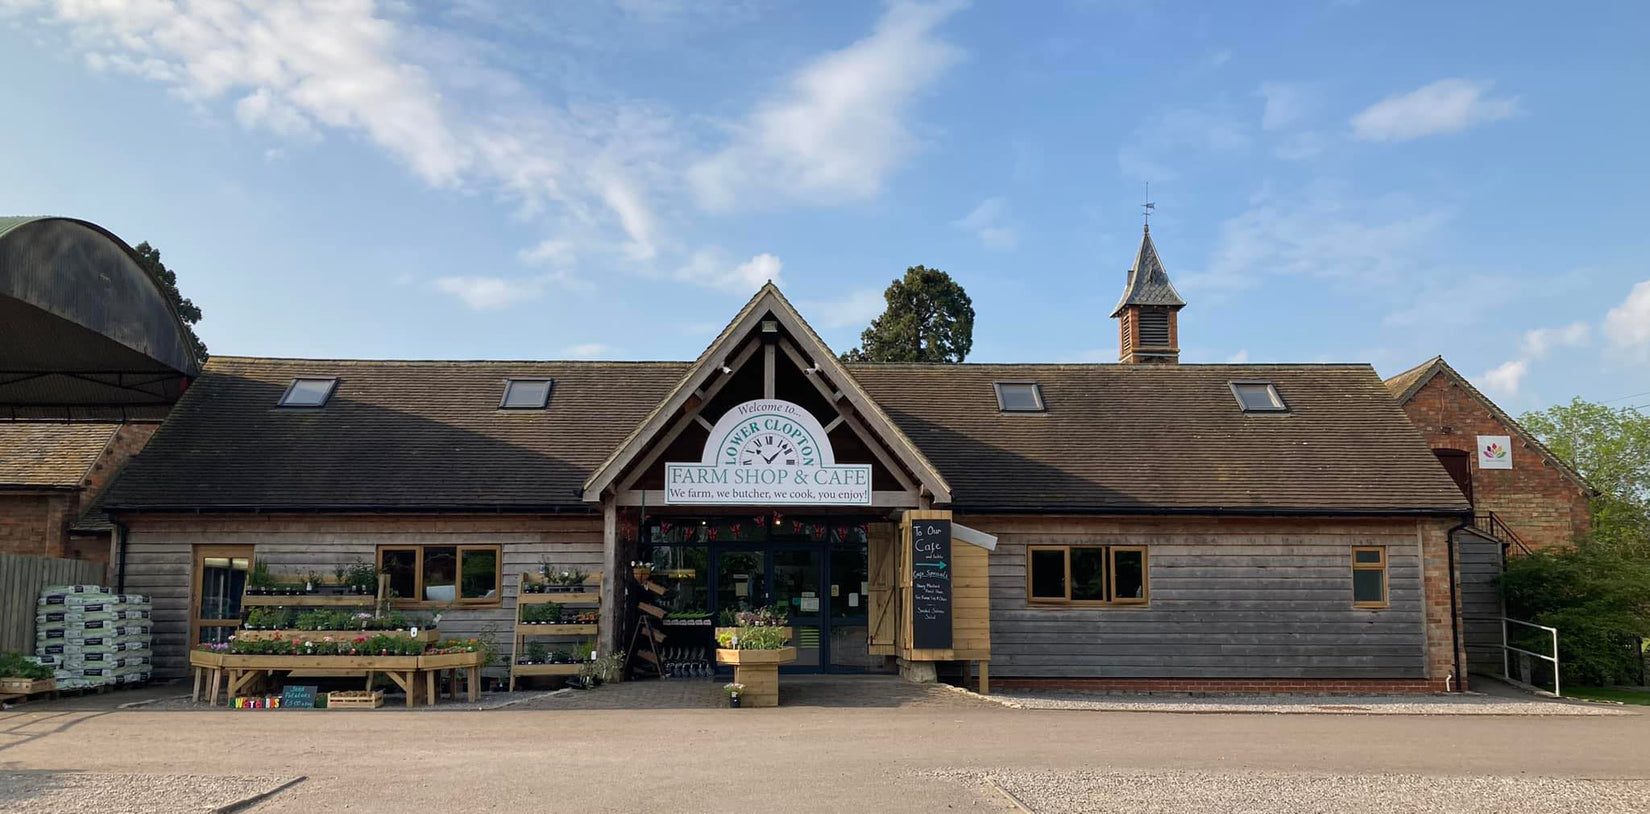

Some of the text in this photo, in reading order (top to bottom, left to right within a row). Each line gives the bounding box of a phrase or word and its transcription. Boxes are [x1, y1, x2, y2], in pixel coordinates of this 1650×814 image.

[738, 402, 801, 417] Welcome to...
[725, 418, 814, 466] LOWER CLOPTON
[671, 468, 867, 485] FARM SHOP & CAFE
[670, 488, 867, 502] We farm, we butcher, we cook, you enjoy!
[913, 526, 941, 536] To Our
[915, 539, 941, 553] Cafe
